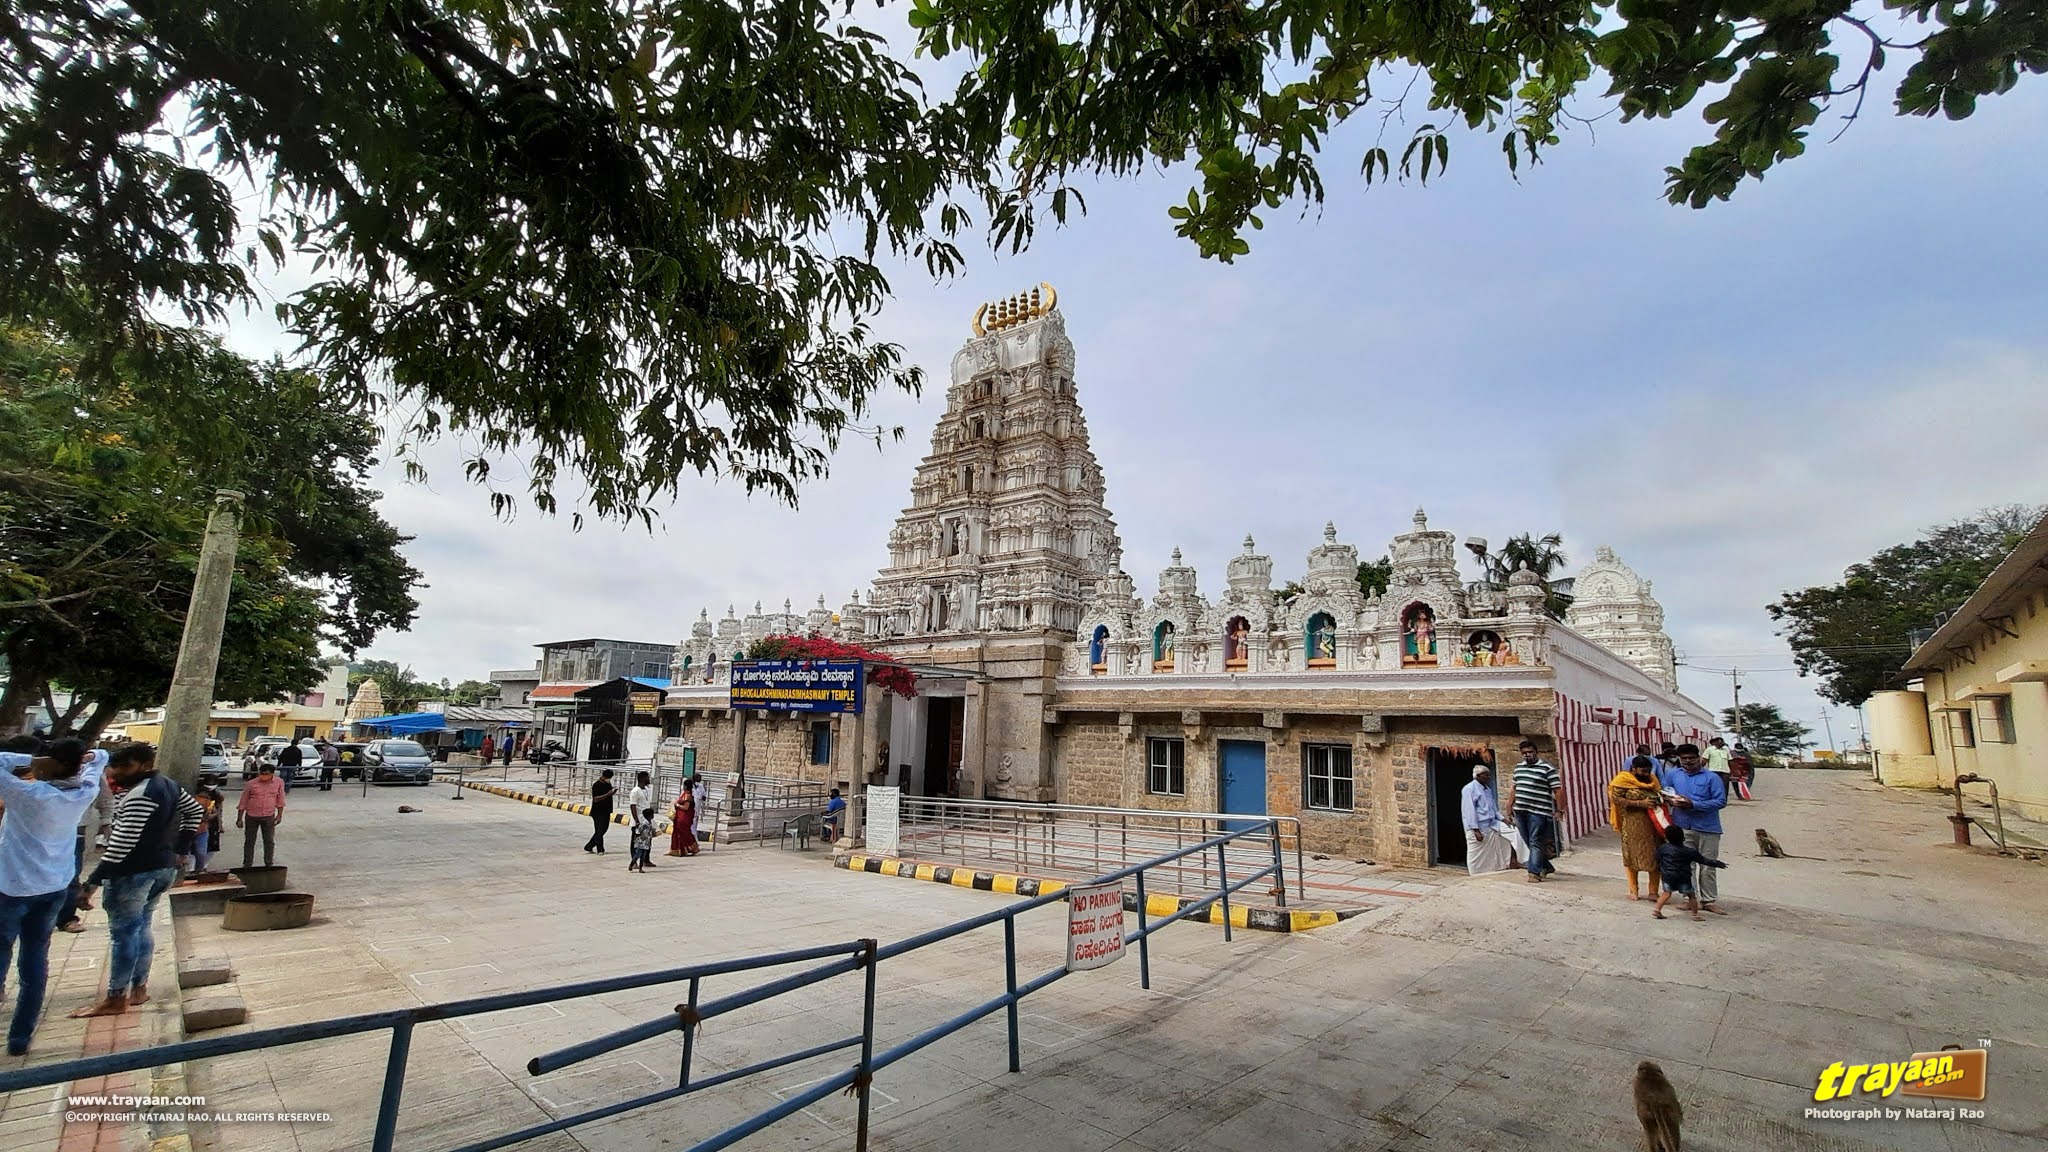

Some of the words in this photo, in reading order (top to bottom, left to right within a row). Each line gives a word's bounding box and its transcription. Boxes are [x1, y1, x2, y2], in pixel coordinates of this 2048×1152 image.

[821, 668, 854, 688] ದೇವಸ್ಥಾನ
[731, 687, 740, 698] SRI
[740, 688, 830, 700] BHOGALAKSHMINARASIMHASWAMY
[831, 689, 855, 701] TEMPLE
[1073, 895, 1087, 912] NO
[1089, 890, 1121, 910] PARKING
[1071, 916, 1096, 936] ವಾಹನ
